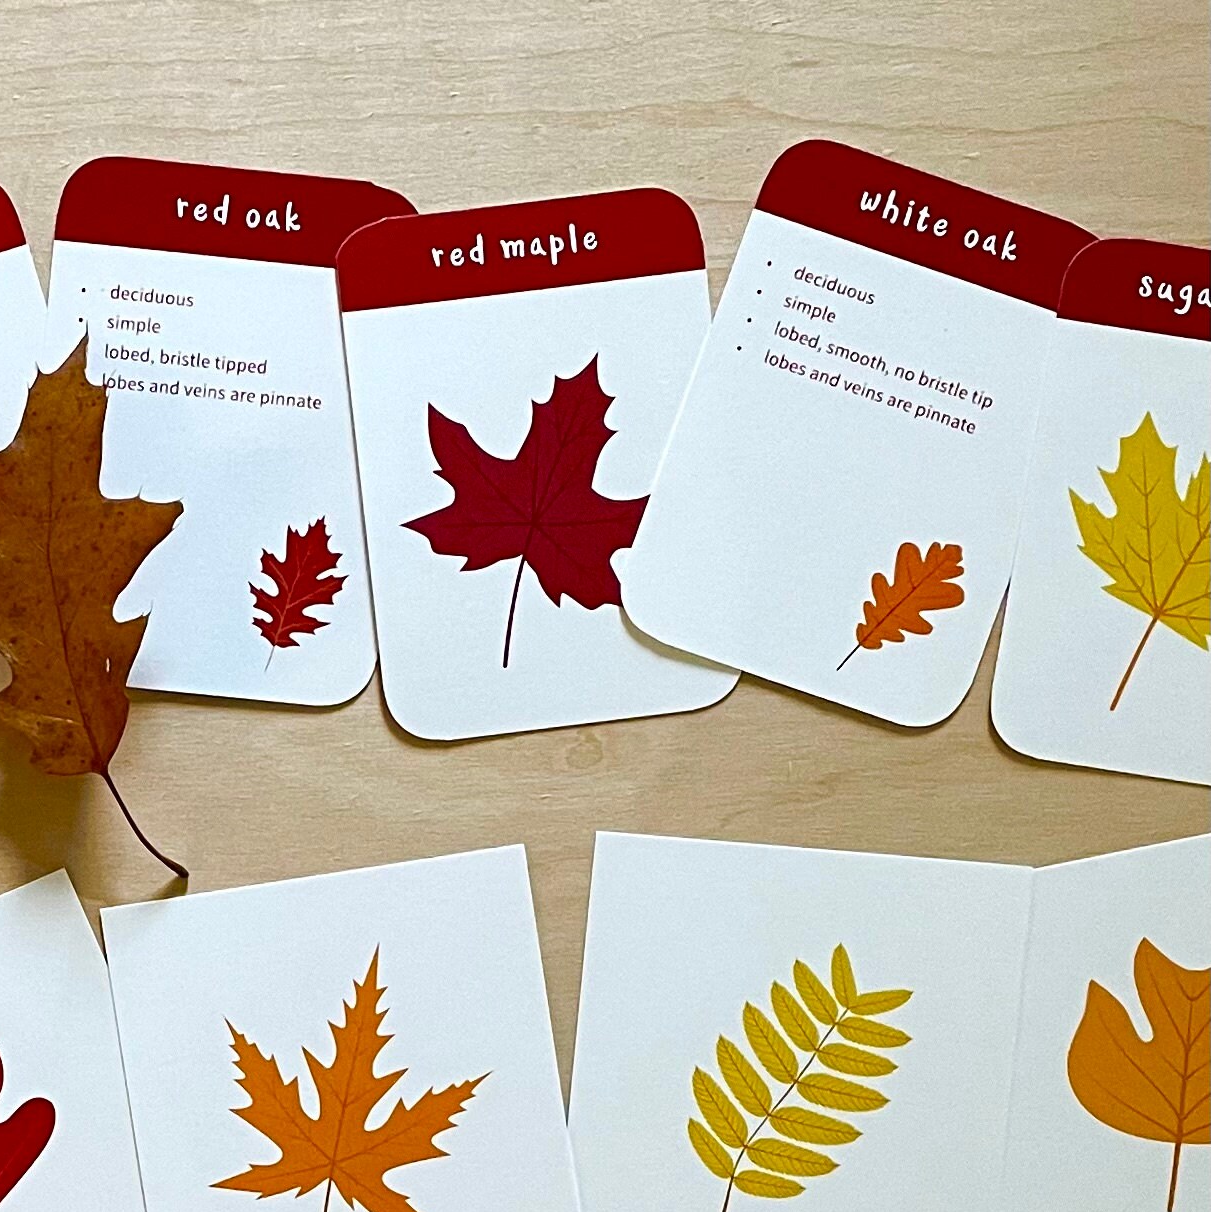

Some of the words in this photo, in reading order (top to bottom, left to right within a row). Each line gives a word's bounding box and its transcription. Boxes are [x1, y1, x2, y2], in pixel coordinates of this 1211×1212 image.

[177, 195, 229, 225] red
[246, 202, 300, 231] oak
[861, 190, 948, 236] white
[964, 230, 1016, 260] oak
[432, 233, 484, 267] red
[500, 224, 597, 265] maple
[111, 285, 193, 307] deciduous
[794, 267, 875, 304] deciduous
[108, 318, 160, 335] simple
[784, 297, 835, 323] simple
[105, 344, 154, 364] lobed,
[160, 349, 210, 368] bristle
[216, 357, 267, 375] tipped
[775, 321, 821, 352] lobed,
[826, 344, 888, 376] smooth,
[894, 367, 915, 381] no
[919, 370, 968, 399] bristle
[972, 391, 993, 410] tip
[103, 373, 145, 392] lobes
[150, 381, 179, 395] and
[184, 386, 225, 399] veins
[231, 391, 255, 403] are
[260, 394, 321, 409] pinnate
[765, 349, 806, 375] lobes
[810, 370, 841, 387] and
[844, 381, 883, 402] veins
[887, 396, 912, 412] are
[914, 406, 975, 434] pinnate
